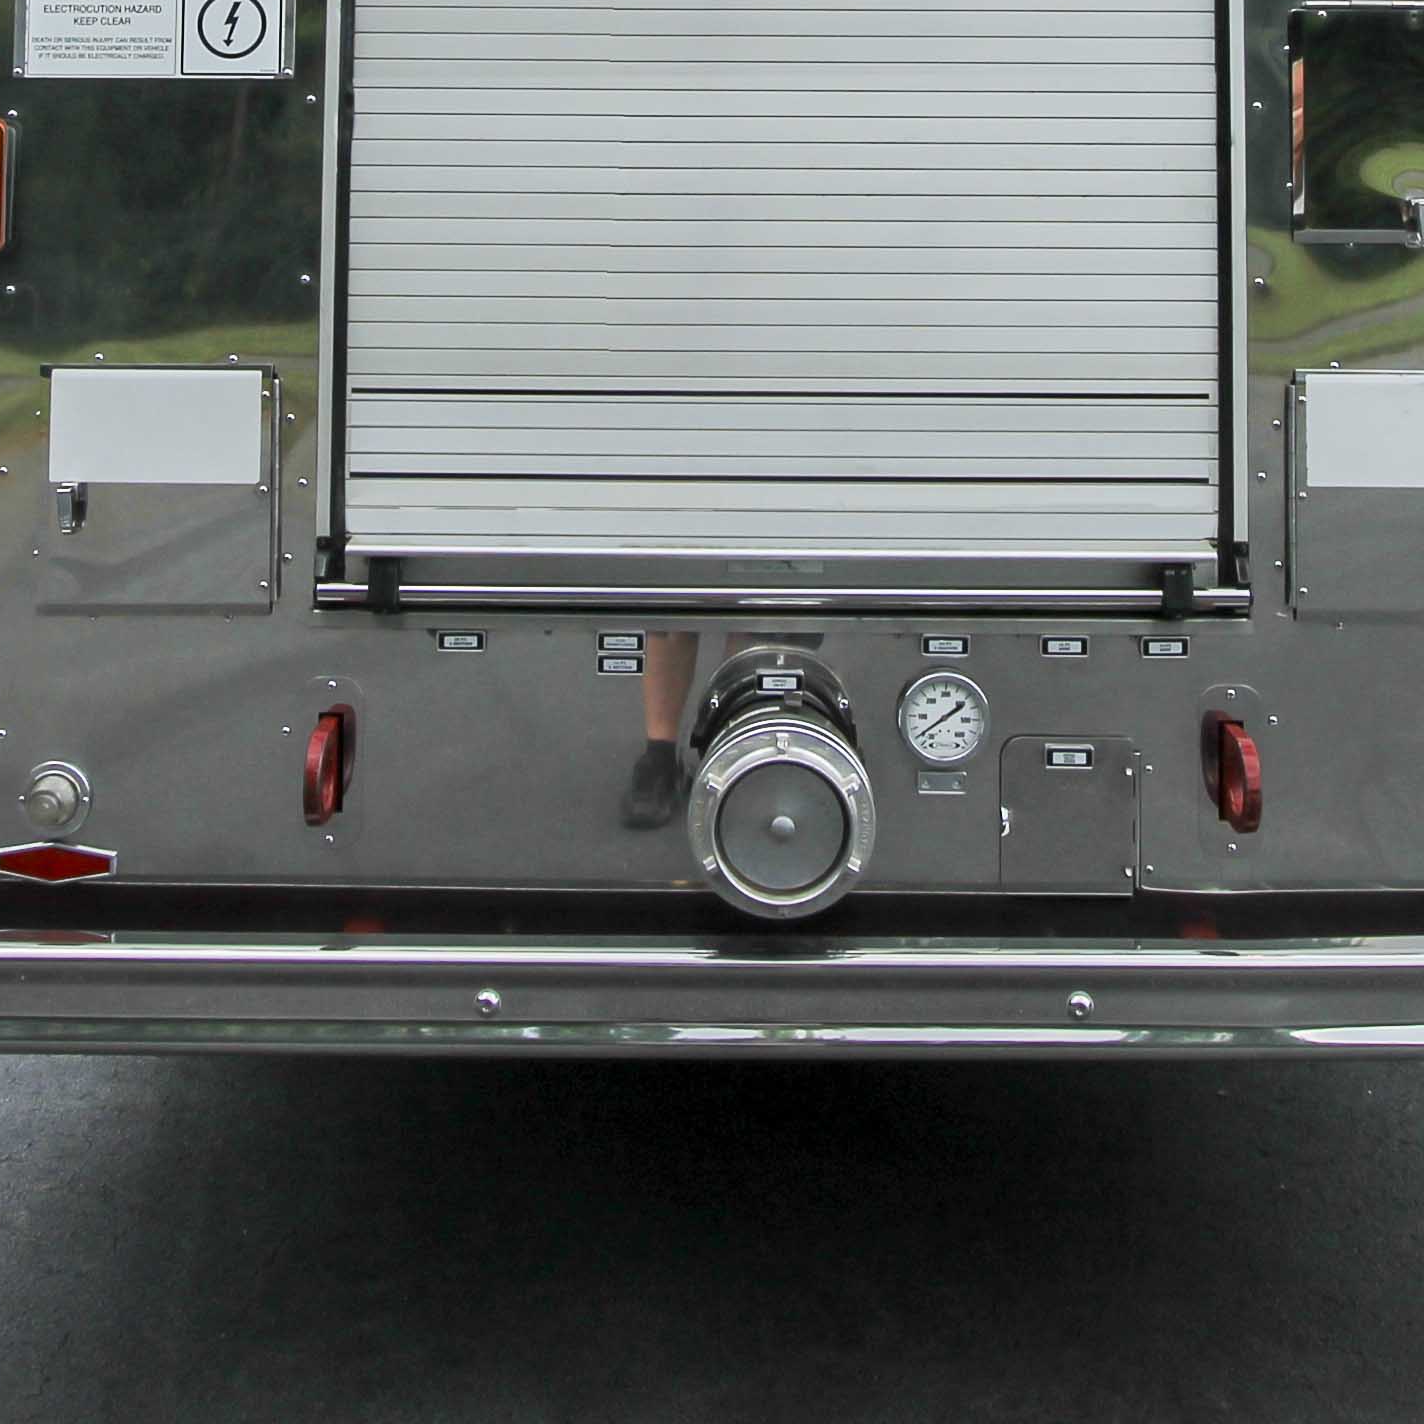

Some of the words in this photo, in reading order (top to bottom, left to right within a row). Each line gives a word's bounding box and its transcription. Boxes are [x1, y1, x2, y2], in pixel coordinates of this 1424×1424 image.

[43, 4, 121, 14] ELECTROCUTION
[124, 5, 162, 14] HAZARD
[73, 16, 98, 26] KEEP
[100, 17, 131, 26] CLEAR
